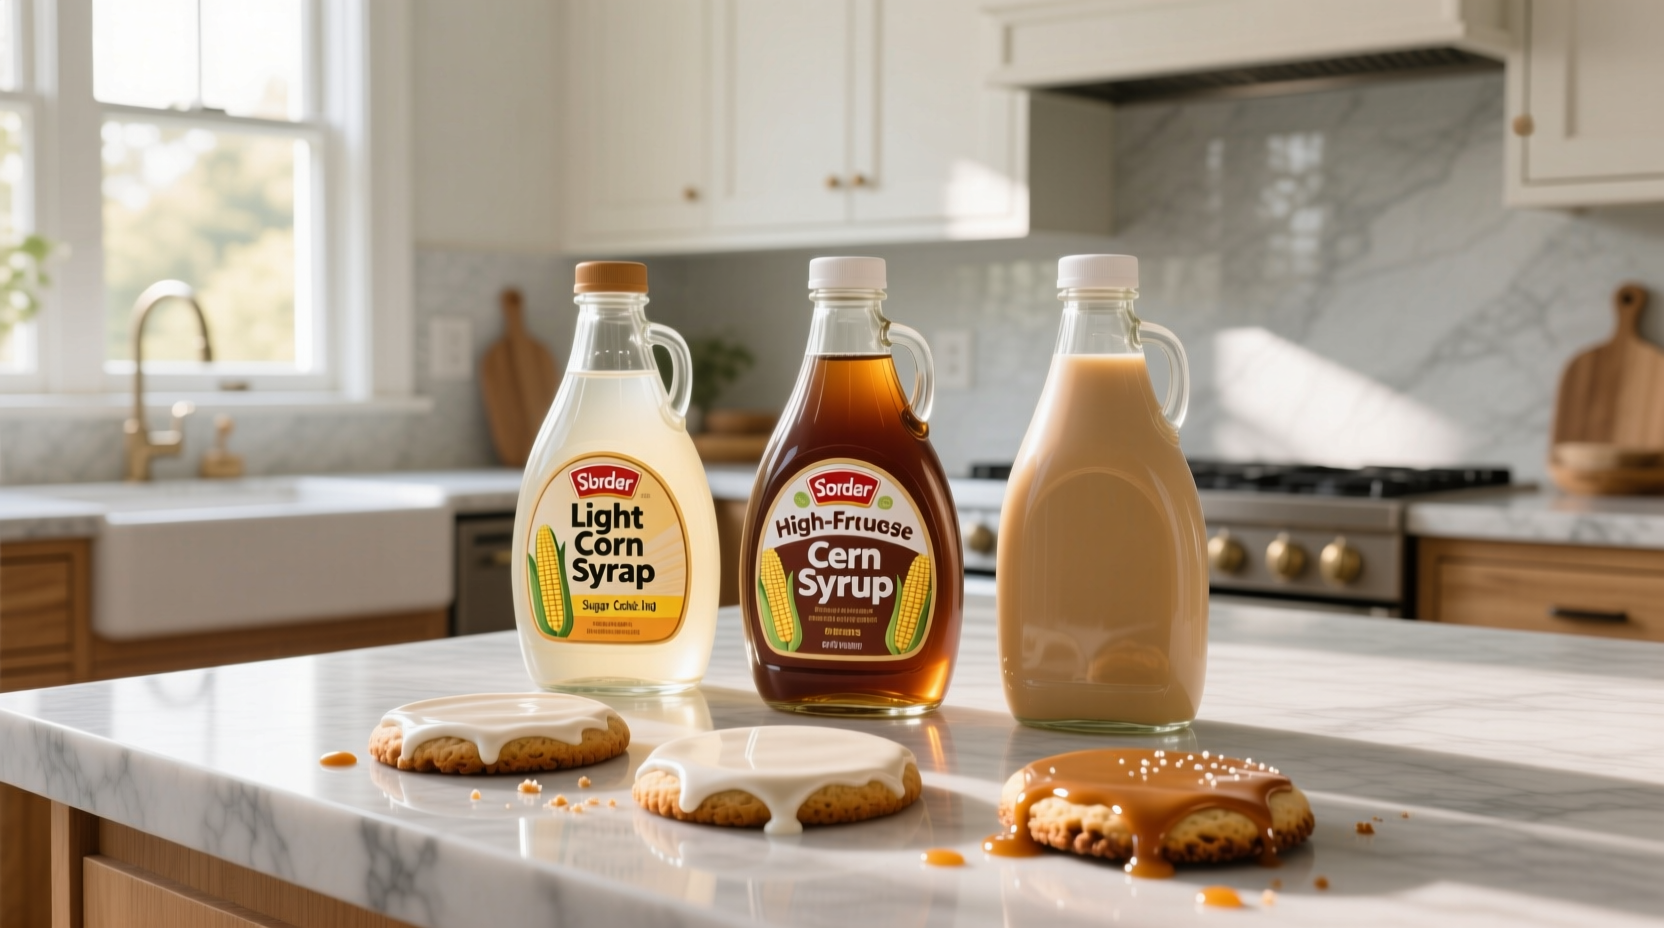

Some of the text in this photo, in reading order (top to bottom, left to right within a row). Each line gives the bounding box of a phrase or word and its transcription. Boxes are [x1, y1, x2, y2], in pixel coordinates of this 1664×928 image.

[572, 502, 643, 535] Light
[574, 531, 643, 557] Corn
[807, 541, 881, 570] Cern
[572, 558, 655, 590] Syrap
[798, 568, 894, 605] Syrup
